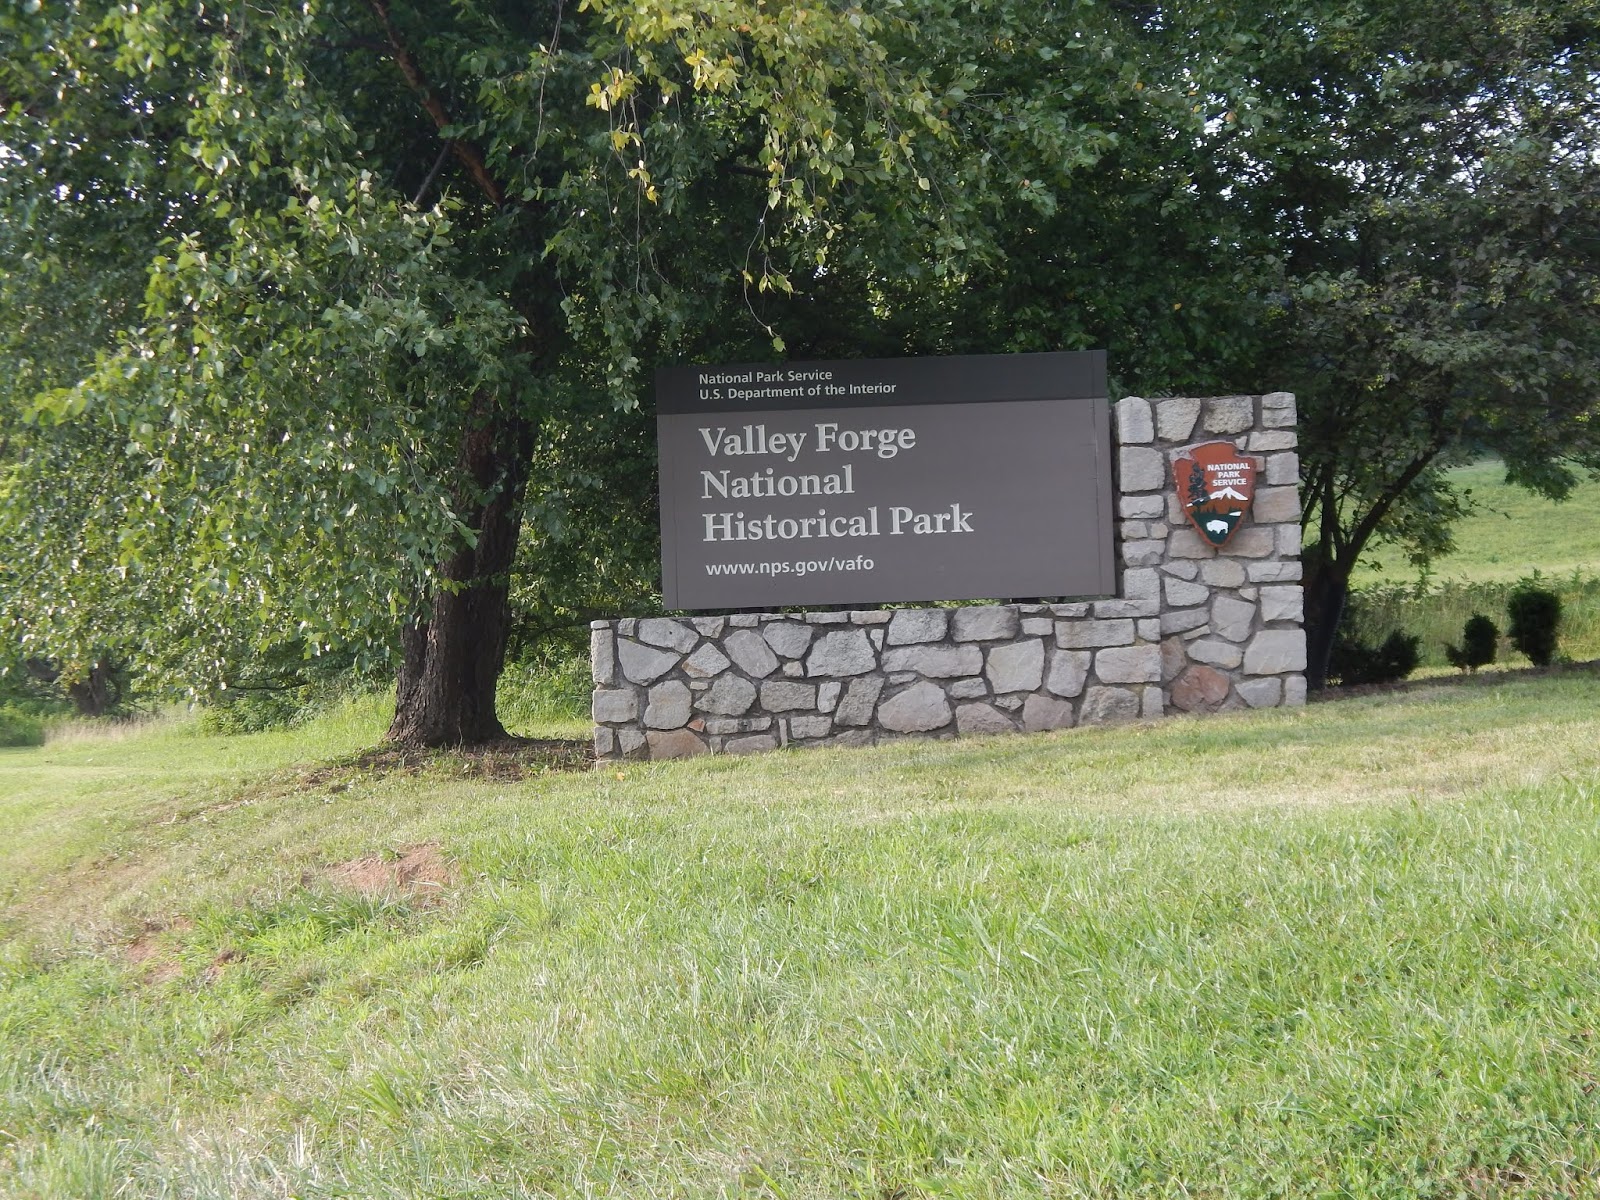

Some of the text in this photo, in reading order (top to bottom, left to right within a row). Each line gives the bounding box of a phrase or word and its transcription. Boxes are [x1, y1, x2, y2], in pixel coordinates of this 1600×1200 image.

[699, 370, 832, 384] National Park Service
[699, 383, 896, 401] U.S. Department of the Interior
[699, 423, 915, 462] Valley Forge
[1207, 462, 1251, 472] NATIONAL
[1217, 470, 1241, 479] PARK
[701, 464, 855, 498] National
[1212, 477, 1247, 487] SERVICE
[702, 503, 974, 541] Historical Park
[706, 555, 874, 577] www.nps.gov/vafo
